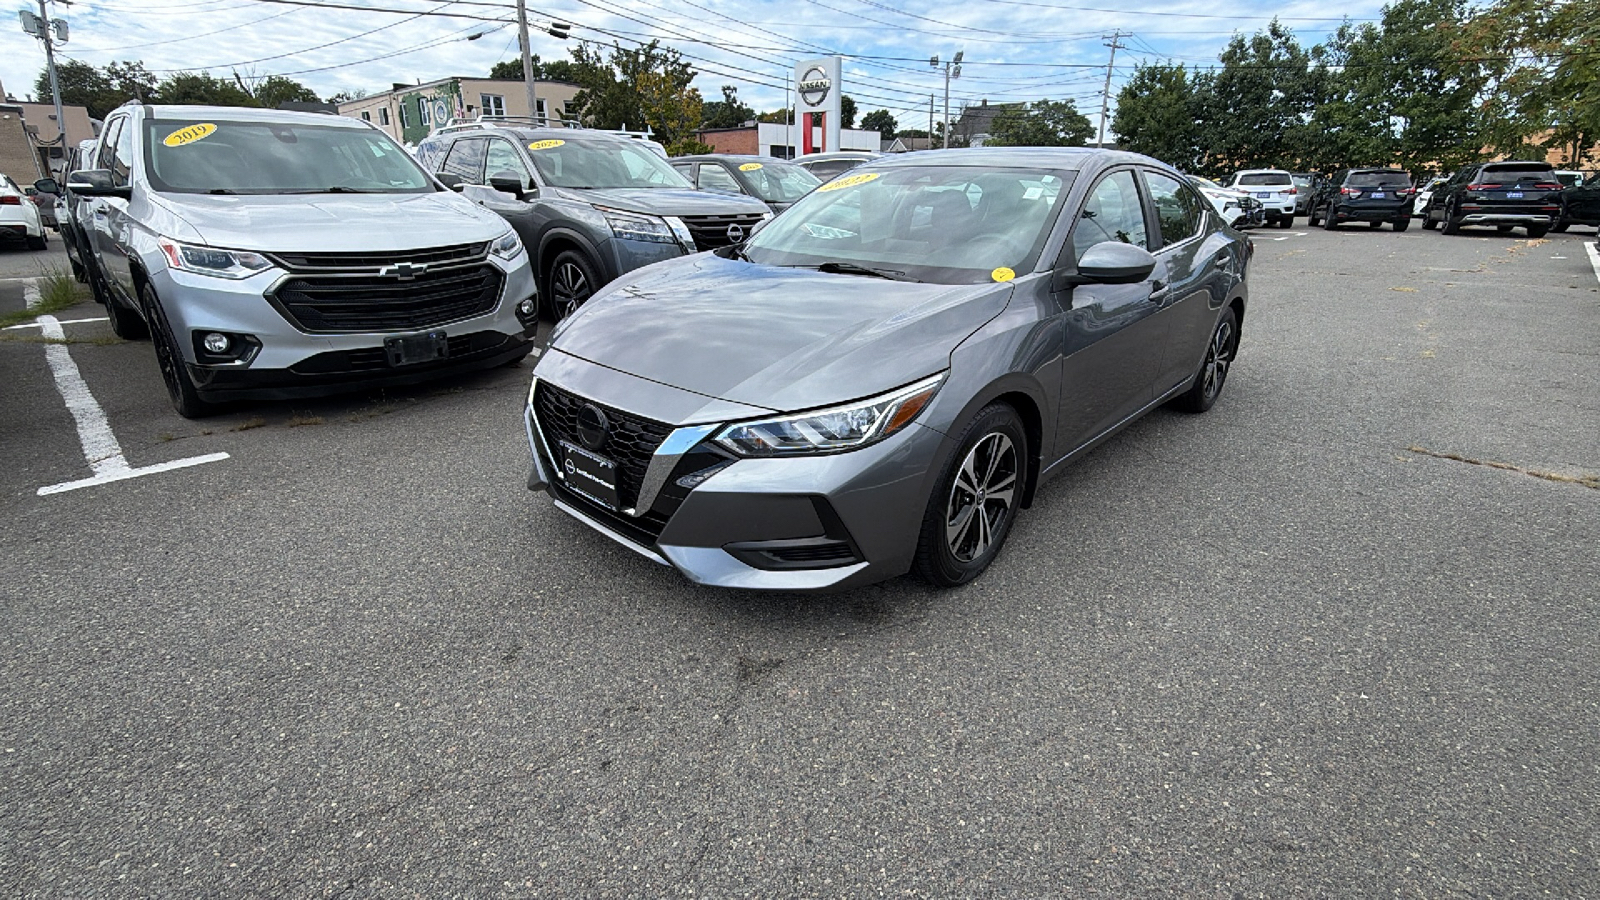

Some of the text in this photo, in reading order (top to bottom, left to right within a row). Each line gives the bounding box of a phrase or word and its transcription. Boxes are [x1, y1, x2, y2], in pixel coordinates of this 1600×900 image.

[800, 81, 827, 90] NISSAN
[173, 125, 207, 144] 2019
[535, 140, 559, 149] 2024
